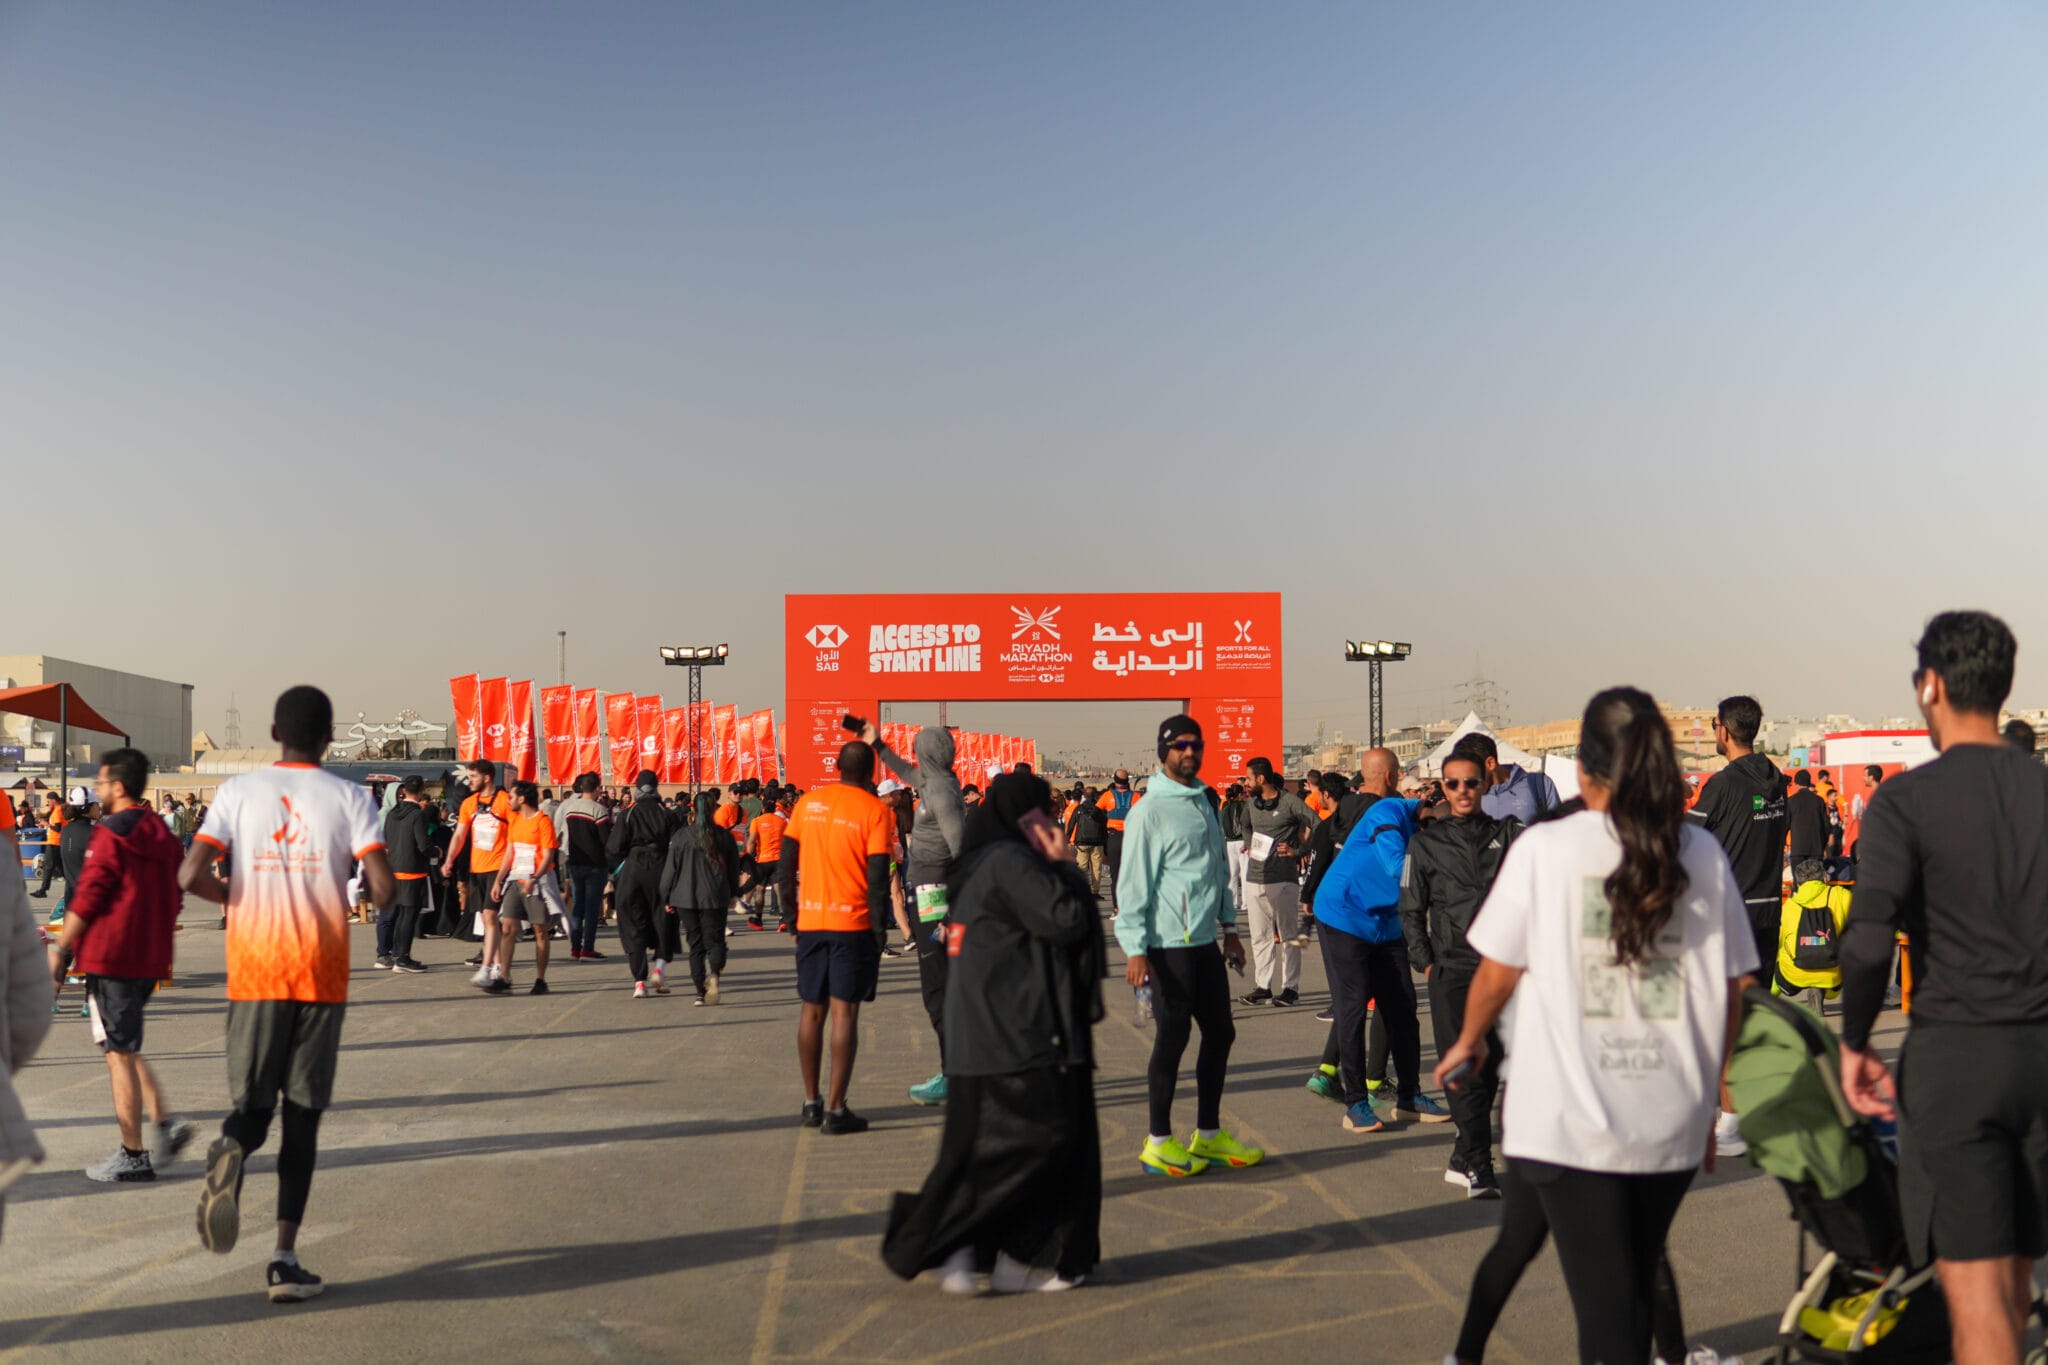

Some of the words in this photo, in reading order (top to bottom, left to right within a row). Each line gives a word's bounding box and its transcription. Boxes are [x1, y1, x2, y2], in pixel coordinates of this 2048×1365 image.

[869, 624, 949, 653] ACCESS
[952, 624, 981, 643] TO
[1092, 620, 1142, 641] خط
[1150, 622, 1203, 648] إلى
[869, 648, 932, 673] START
[934, 644, 982, 672] LINE
[1000, 653, 1072, 662] MARATHON
[1012, 643, 1060, 653] RIYADH
[816, 662, 839, 672] SAB
[1092, 650, 1203, 677] البداية
